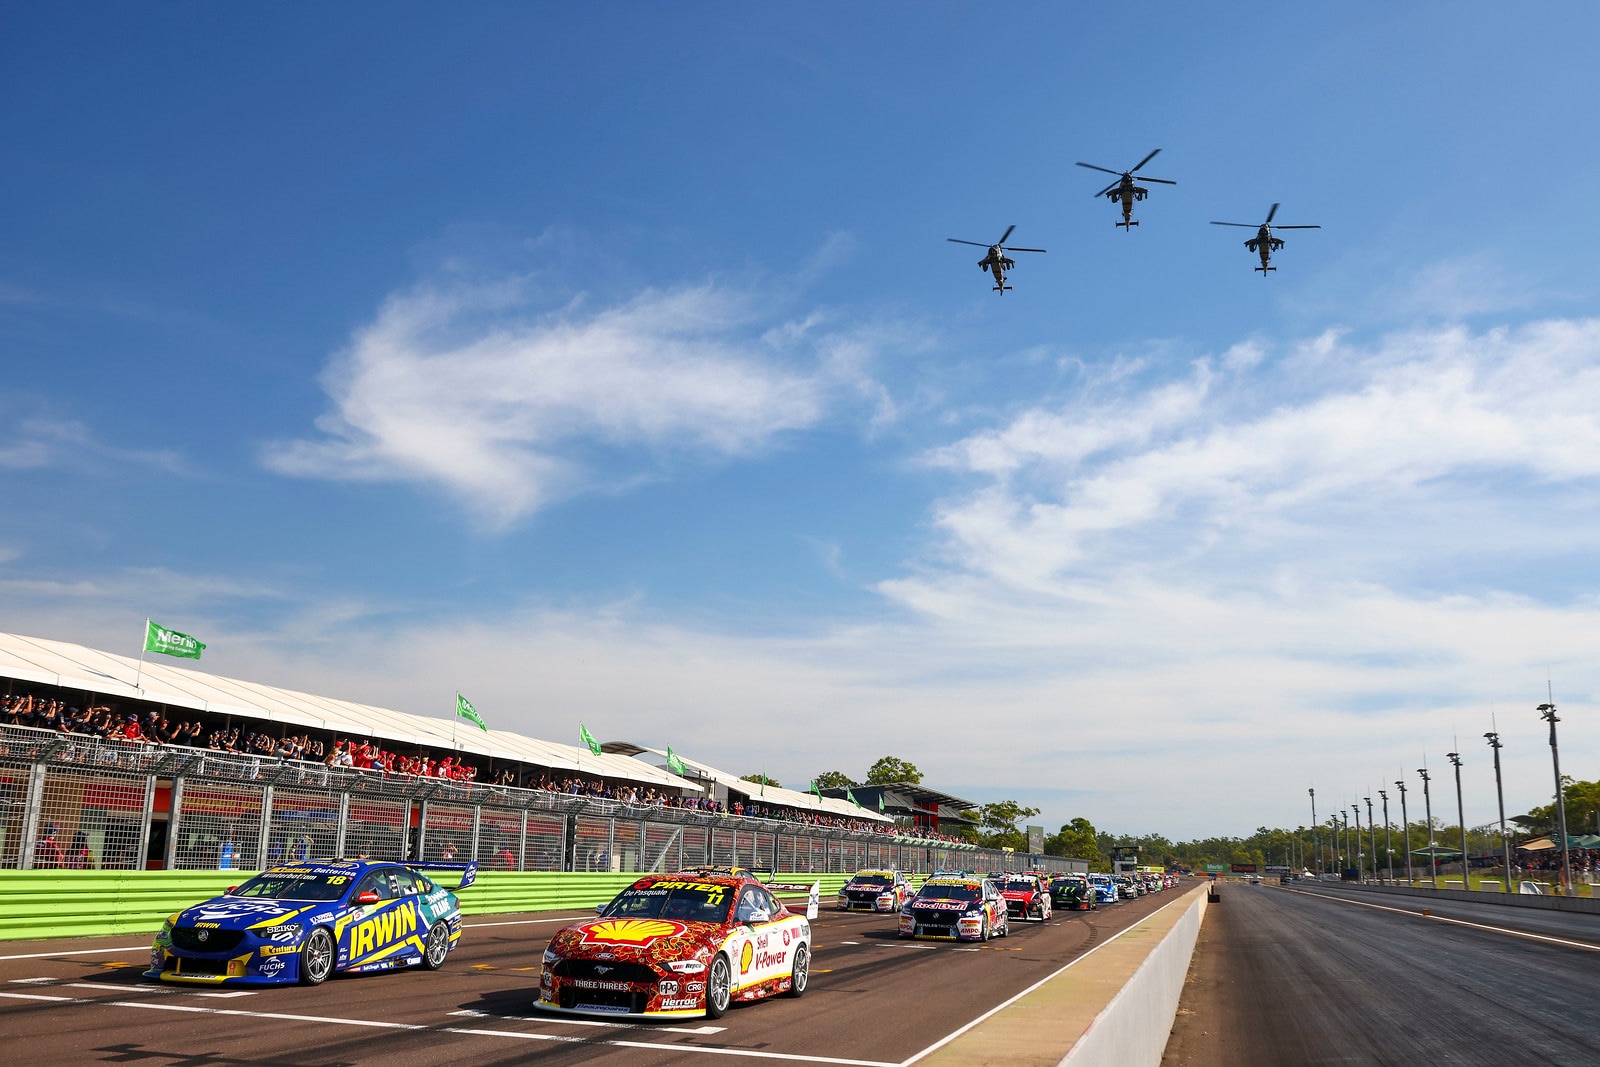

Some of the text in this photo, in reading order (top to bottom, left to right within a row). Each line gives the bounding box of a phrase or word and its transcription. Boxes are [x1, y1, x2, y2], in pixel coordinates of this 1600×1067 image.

[313, 867, 357, 877] Batteries
[326, 876, 347, 885] 18
[650, 882, 730, 893] PIRTEK
[706, 893, 725, 906] 11
[912, 902, 969, 911] Red Bull
[267, 924, 299, 934] SEIKO
[349, 900, 417, 961] IRWIN
[757, 934, 768, 950] Shell
[755, 951, 787, 970] V-Power
[259, 962, 286, 972] FUCHS
[575, 980, 629, 991] THREE THREES
[662, 997, 697, 1006] Herrod
